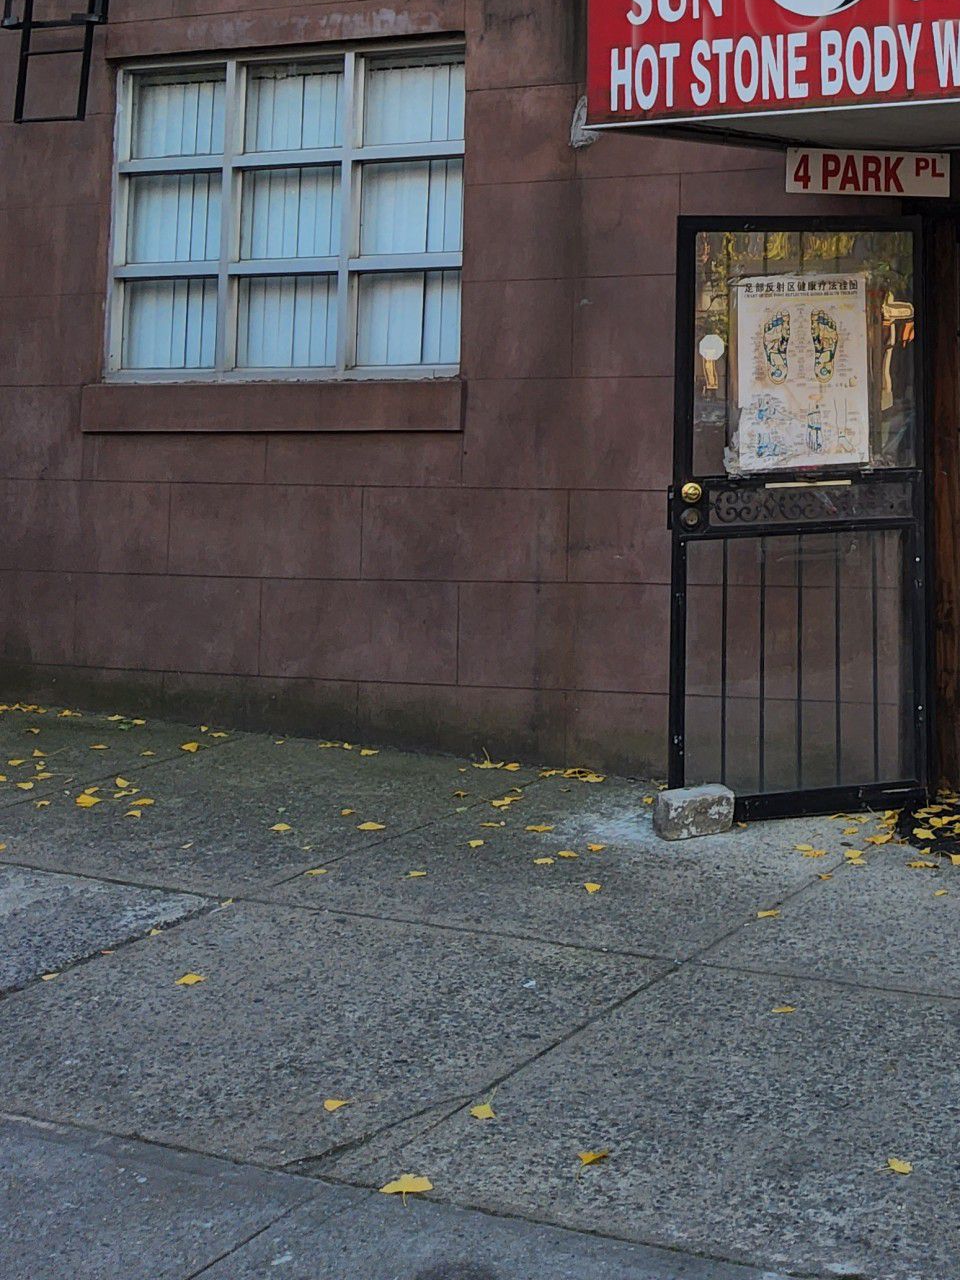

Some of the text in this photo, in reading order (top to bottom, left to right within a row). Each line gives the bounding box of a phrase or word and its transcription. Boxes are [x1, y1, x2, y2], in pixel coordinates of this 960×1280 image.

[610, 42, 680, 111] HOT
[690, 31, 809, 106] STONE
[820, 23, 922, 96] BODY
[793, 153, 945, 193] 4 PARK PL
